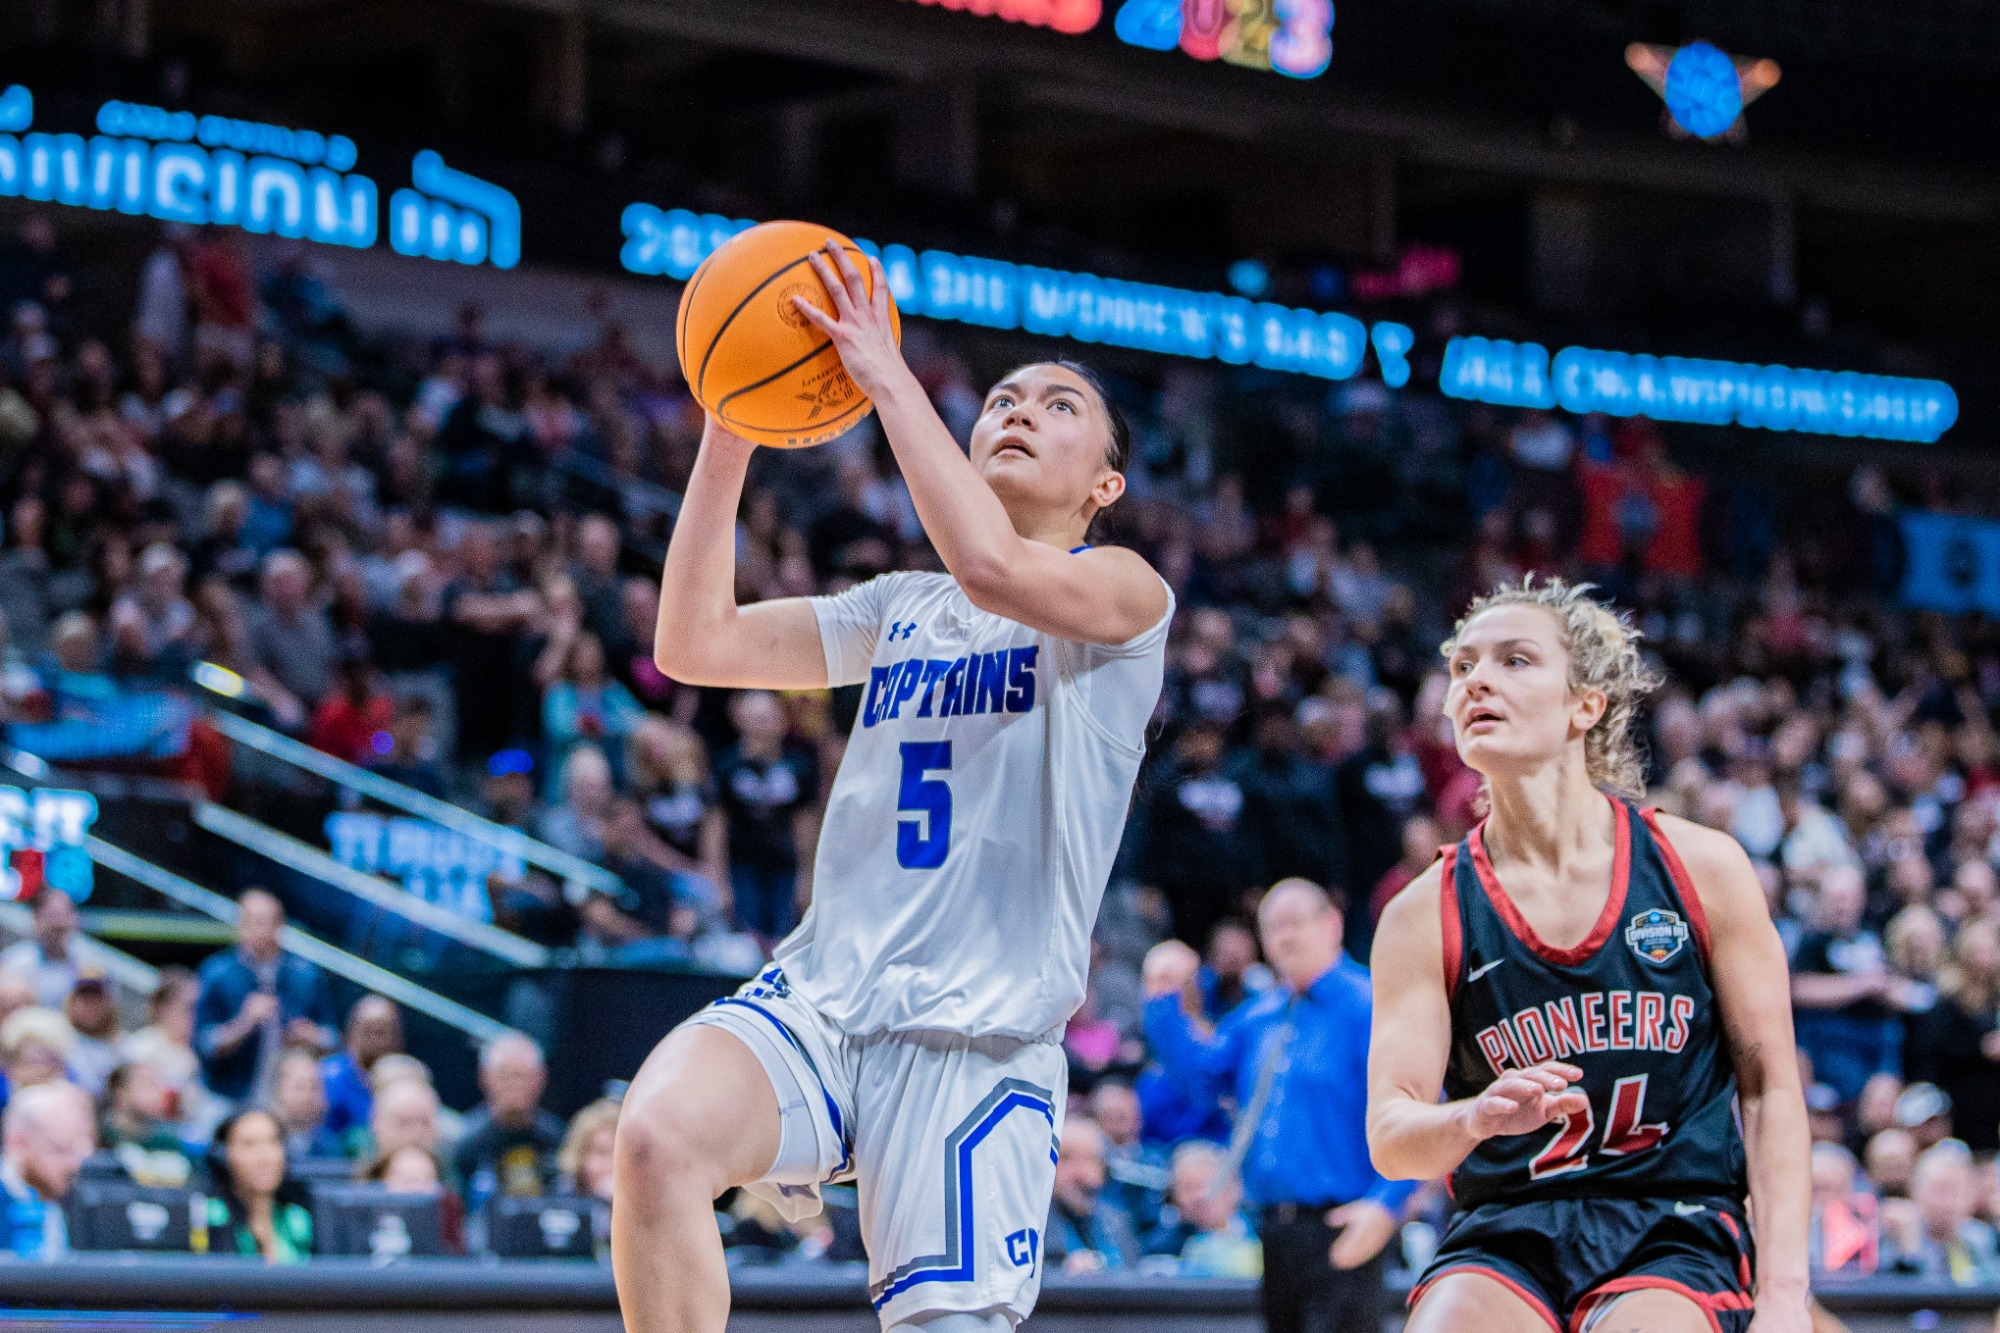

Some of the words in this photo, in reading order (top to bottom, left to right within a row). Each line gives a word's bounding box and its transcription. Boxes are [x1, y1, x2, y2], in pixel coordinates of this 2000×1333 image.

[862, 645, 1039, 729] CAPTAINS
[896, 740, 952, 870] 5
[1475, 990, 1694, 1076] PIONEERS
